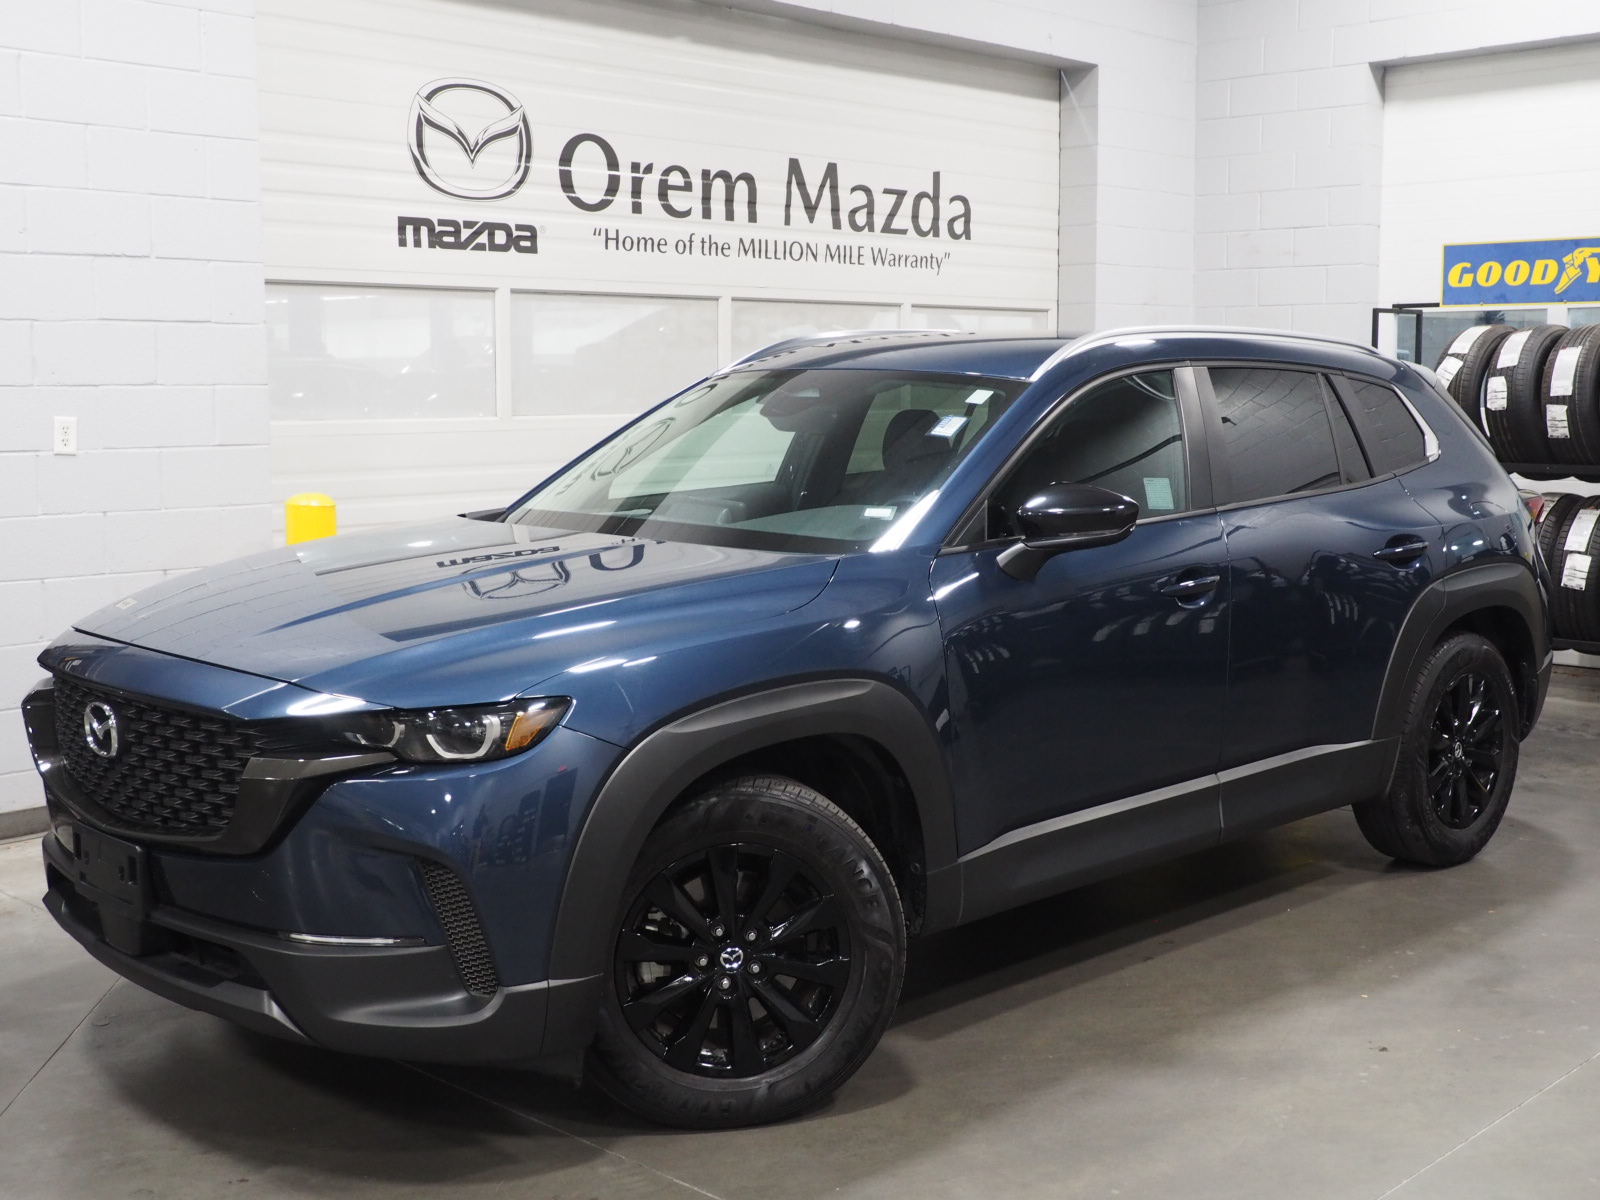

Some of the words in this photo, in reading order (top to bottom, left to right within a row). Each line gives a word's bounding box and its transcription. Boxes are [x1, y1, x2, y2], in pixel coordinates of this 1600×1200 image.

[558, 133, 757, 223] Orem
[783, 157, 973, 241] Mazda
[397, 215, 539, 255] mazda
[674, 232, 696, 255] of
[700, 234, 731, 258] the
[737, 237, 818, 263] MILLION
[824, 243, 865, 266] MILE
